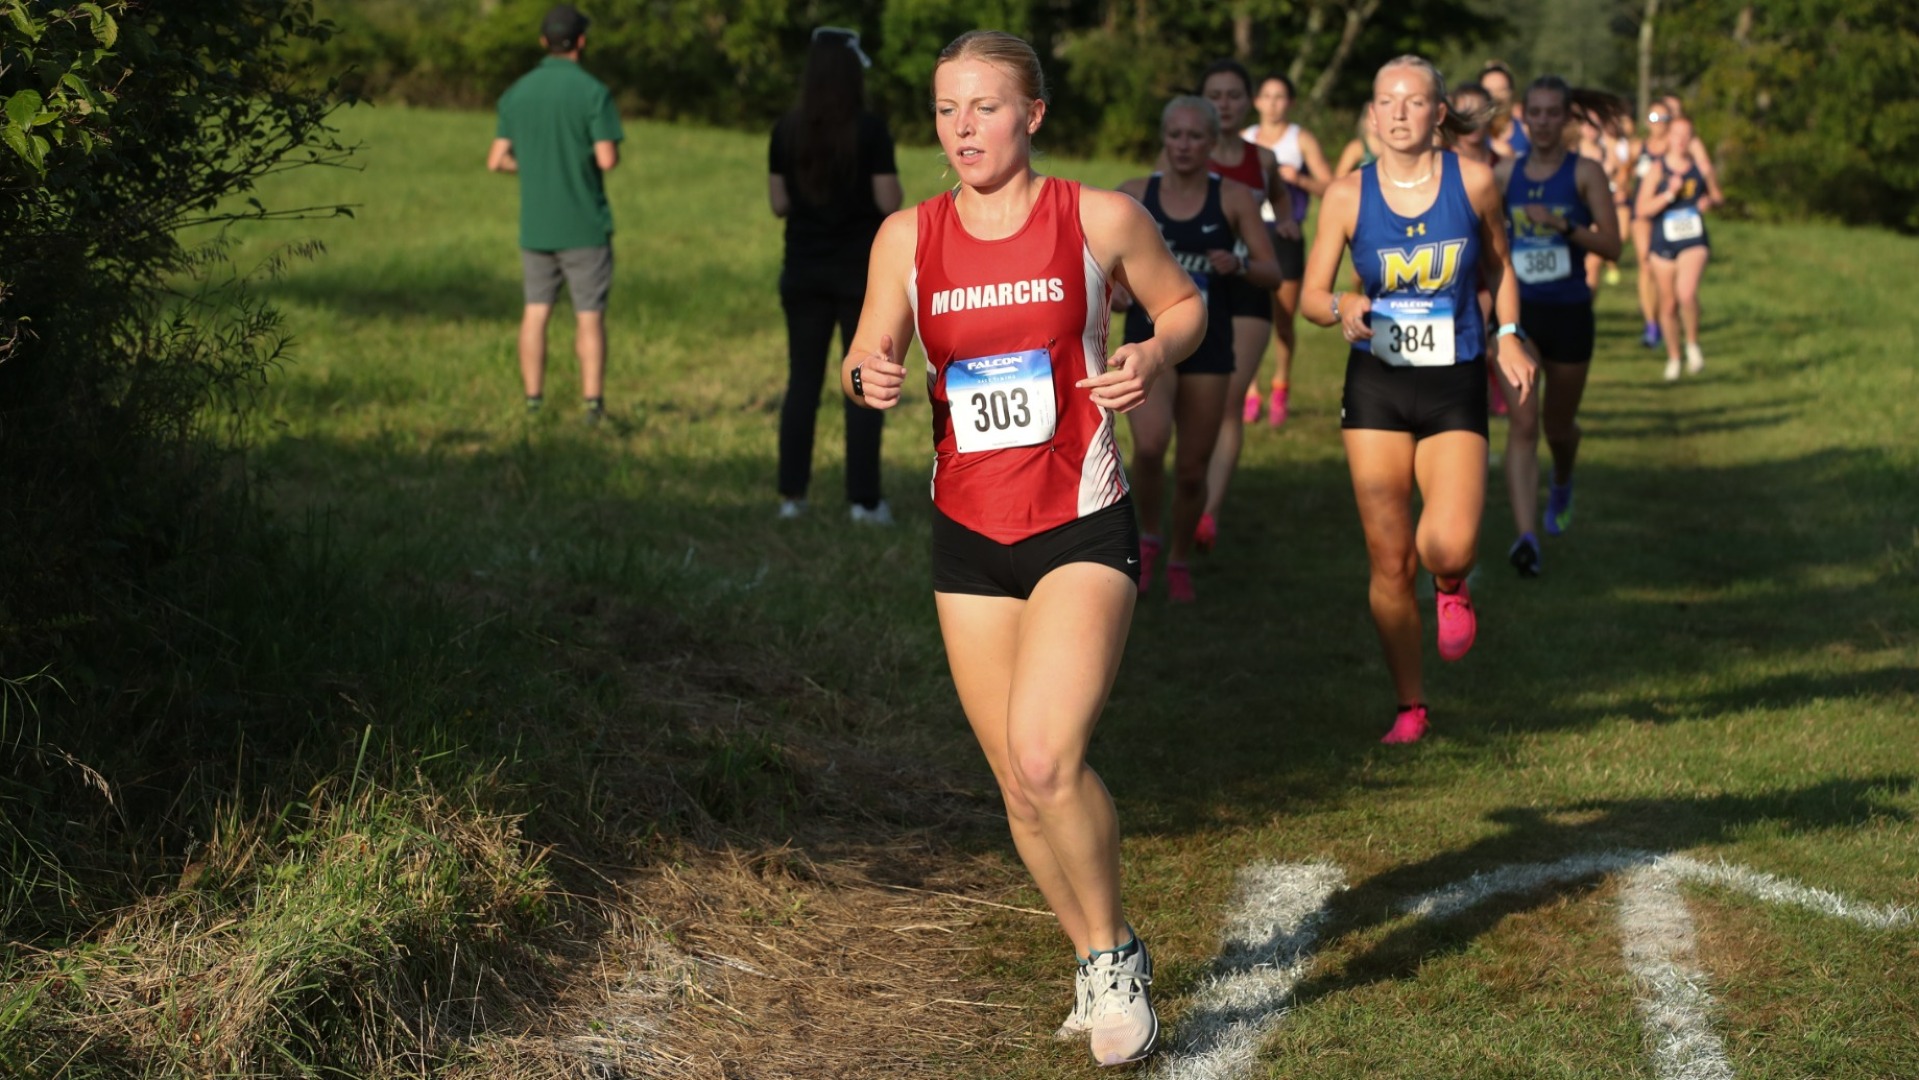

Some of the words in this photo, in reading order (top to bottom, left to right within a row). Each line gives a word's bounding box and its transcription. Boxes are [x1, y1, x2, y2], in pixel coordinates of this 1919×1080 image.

[1377, 238, 1467, 294] MU
[1524, 250, 1557, 275] 380
[931, 277, 1065, 316] MONARCHS
[1388, 301, 1434, 309] FALCON
[1389, 324, 1436, 354] 384
[967, 355, 1024, 371] FALCON
[971, 387, 1031, 433] 303
